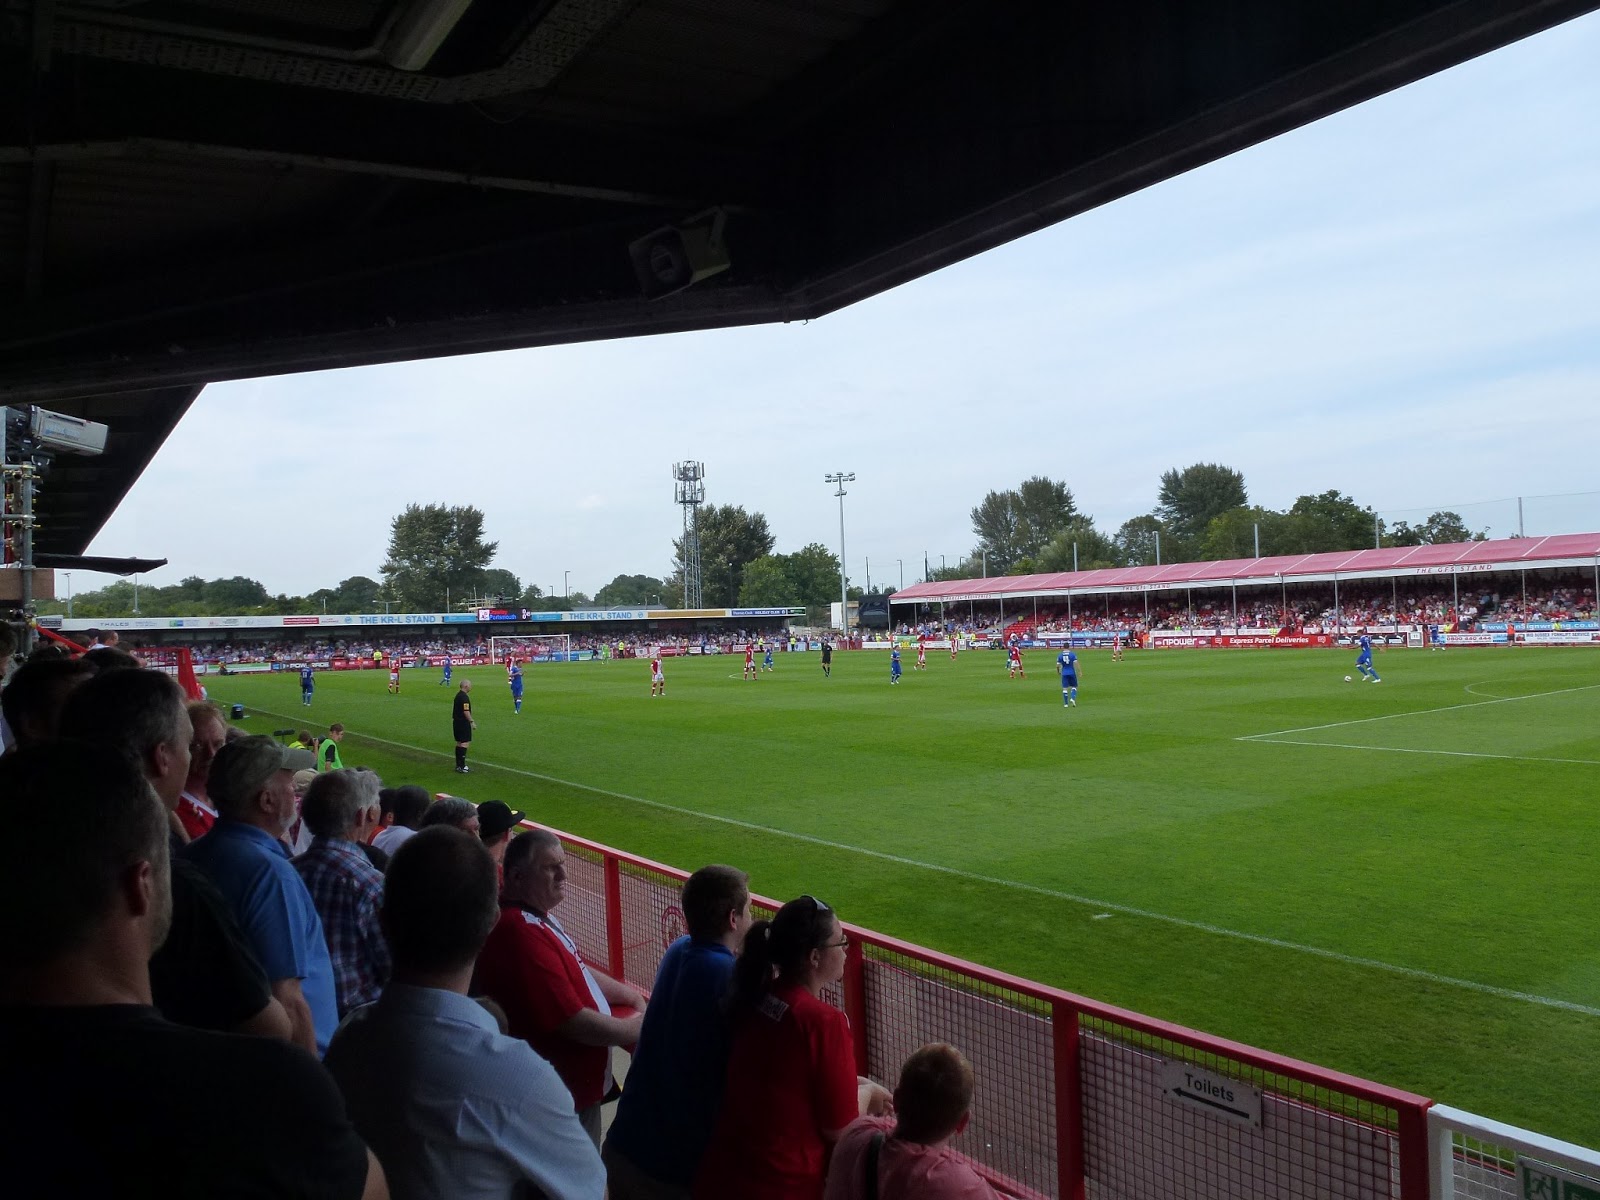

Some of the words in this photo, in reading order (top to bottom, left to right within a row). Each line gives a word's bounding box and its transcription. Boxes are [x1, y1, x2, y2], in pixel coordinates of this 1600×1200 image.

[1437, 565, 1454, 573] GFS
[1460, 564, 1493, 572] STAND
[359, 616, 378, 624] THE
[381, 616, 403, 624] KR-L
[405, 615, 436, 623] STAND
[1162, 638, 1197, 646] npower
[1229, 636, 1254, 645] Express
[1276, 635, 1309, 643] Deliveries
[440, 658, 474, 666] nower
[1062, 656, 1070, 664] 4
[1184, 1073, 1234, 1102] Toilets
